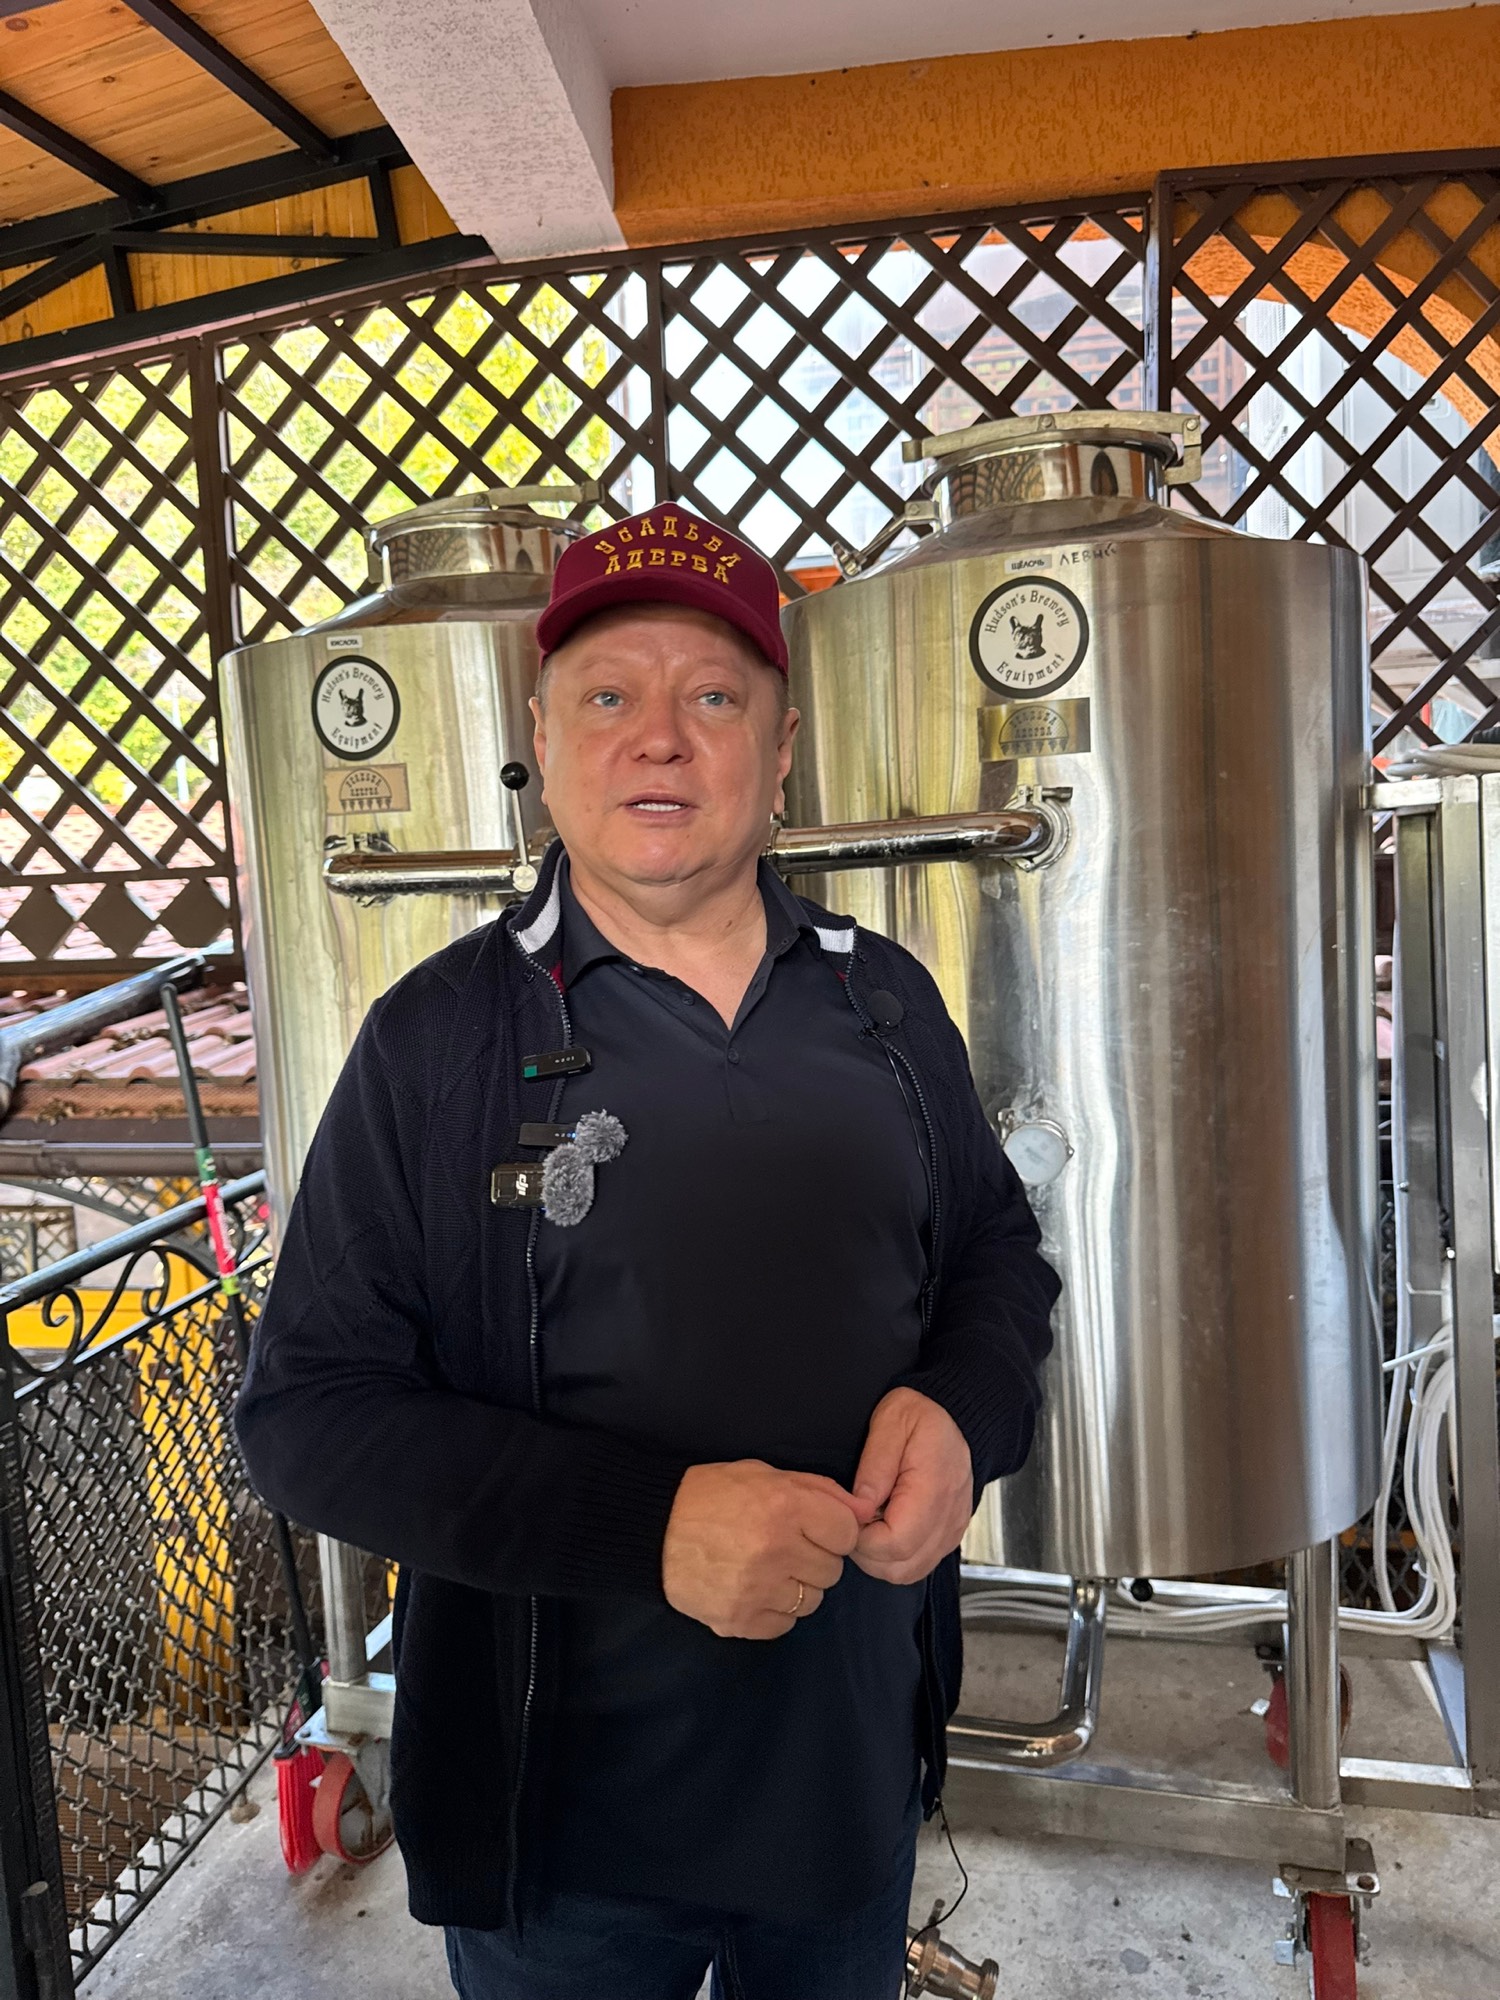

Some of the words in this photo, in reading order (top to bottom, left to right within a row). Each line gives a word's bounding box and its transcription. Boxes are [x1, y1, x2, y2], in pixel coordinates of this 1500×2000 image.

[594, 515, 742, 568] УСАДЬБА
[604, 548, 729, 584] АДЕРБА
[984, 593, 1026, 633] Hudson's
[1029, 590, 1070, 627] Brewery
[321, 669, 350, 703] Hudson's
[352, 667, 385, 700] Brewery
[996, 653, 1065, 685] Equipment
[331, 722, 383, 749] Equipment
